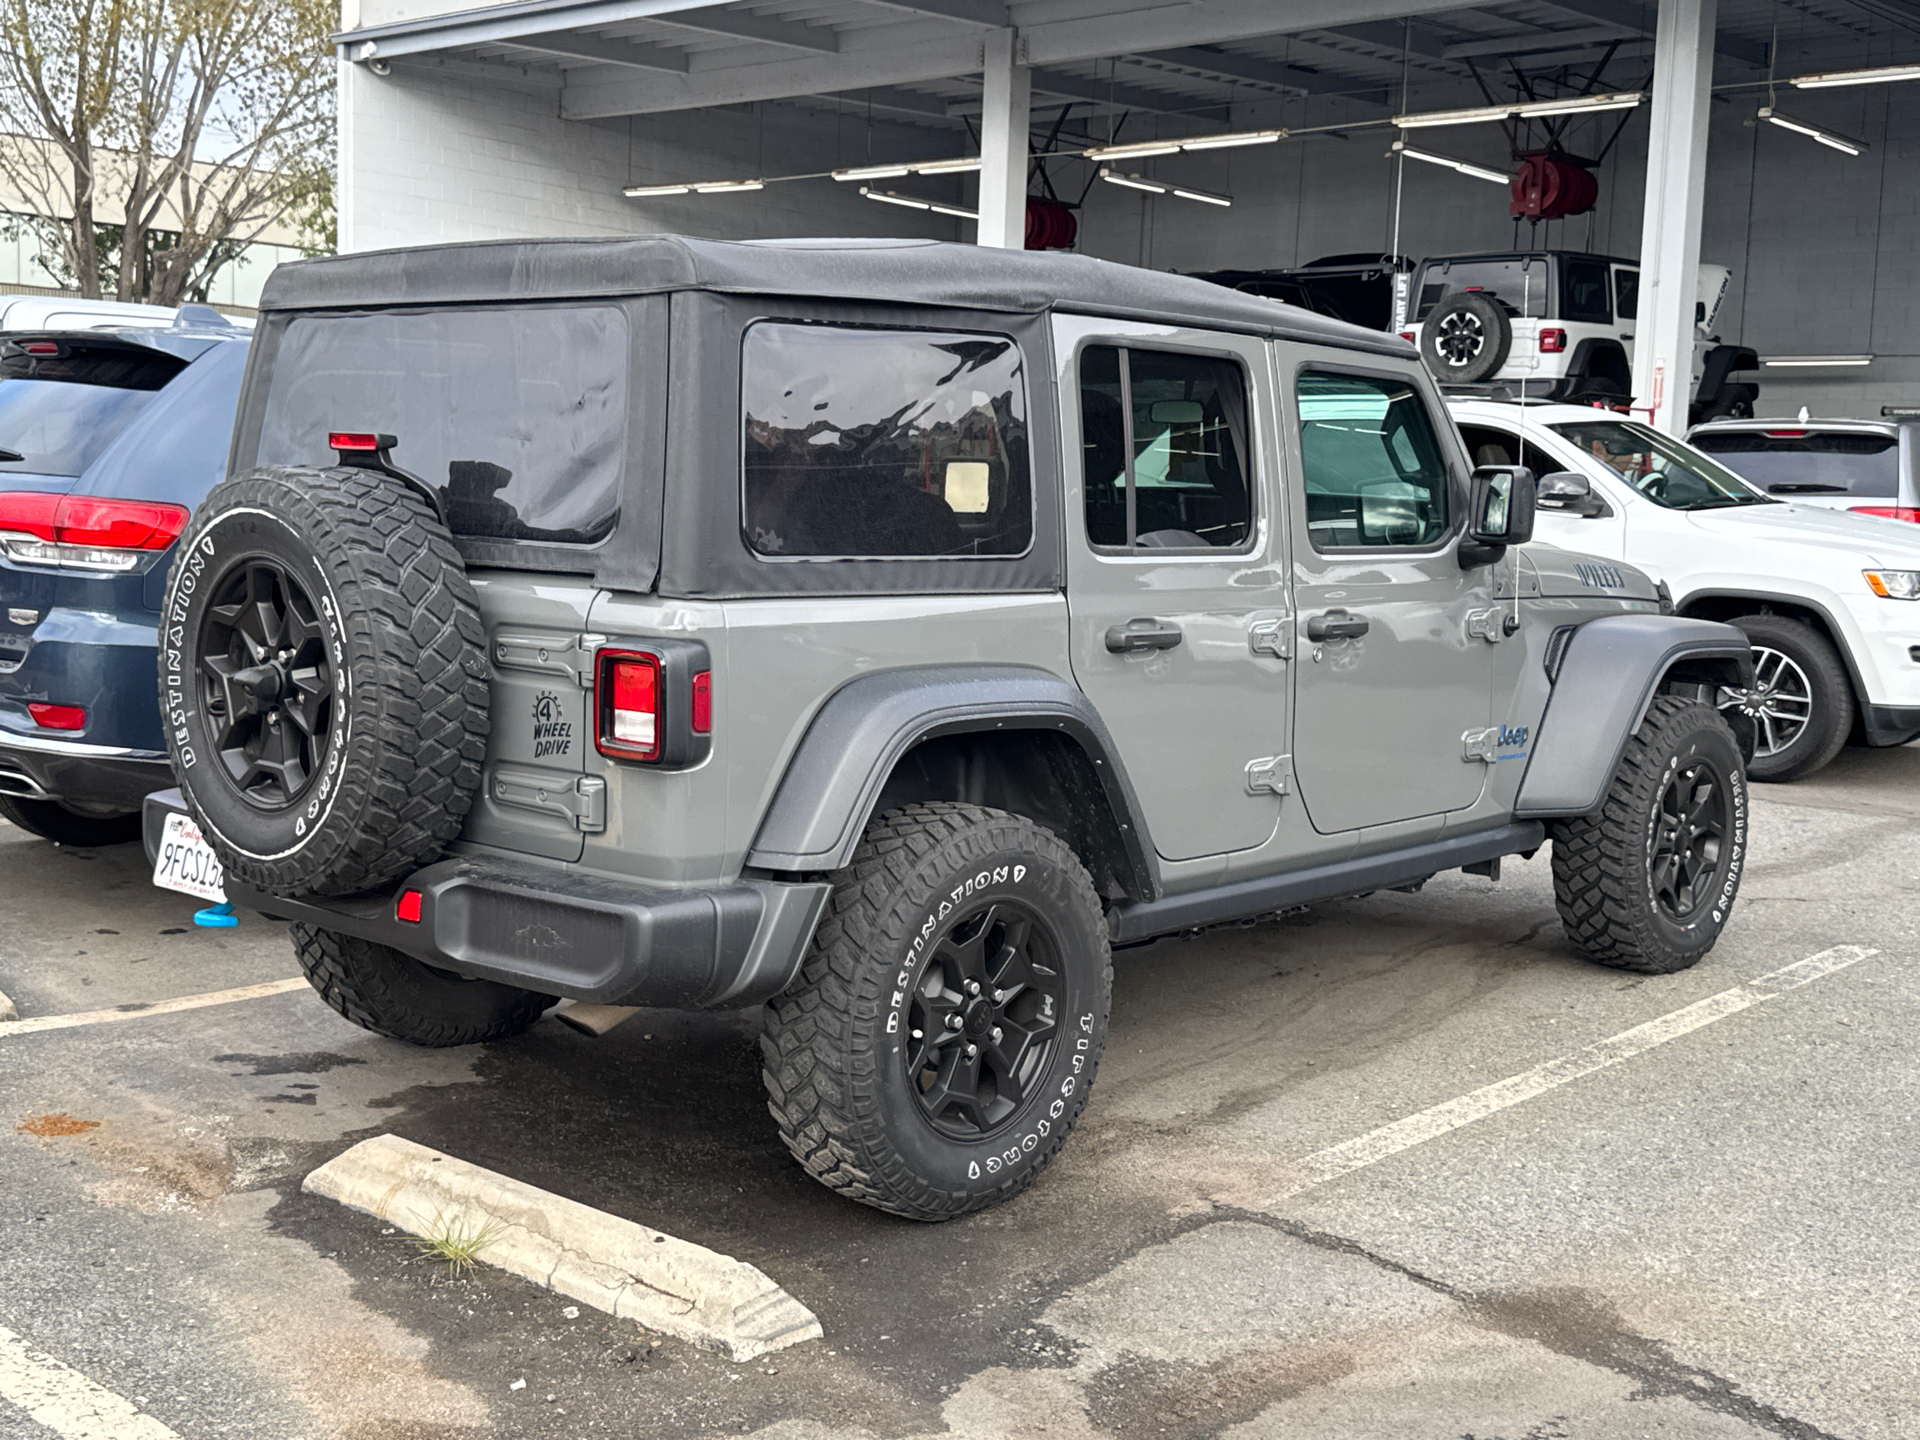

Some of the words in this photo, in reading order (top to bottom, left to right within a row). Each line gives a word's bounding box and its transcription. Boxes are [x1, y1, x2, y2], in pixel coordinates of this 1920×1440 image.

[1396, 274, 1408, 298] LIFT
[1706, 276, 1729, 329] RUBICON
[1394, 299, 1407, 335] OTARY
[1573, 563, 1625, 588] WILLYS
[167, 554, 205, 769] DESTINATION
[539, 700, 552, 722] 4
[534, 722, 572, 741] WHEEL
[1497, 723, 1529, 748] Jeep
[534, 739, 571, 758] DRIVE
[1718, 769, 1745, 911] DESTINATION
[886, 865, 1010, 1034] DESTINATION
